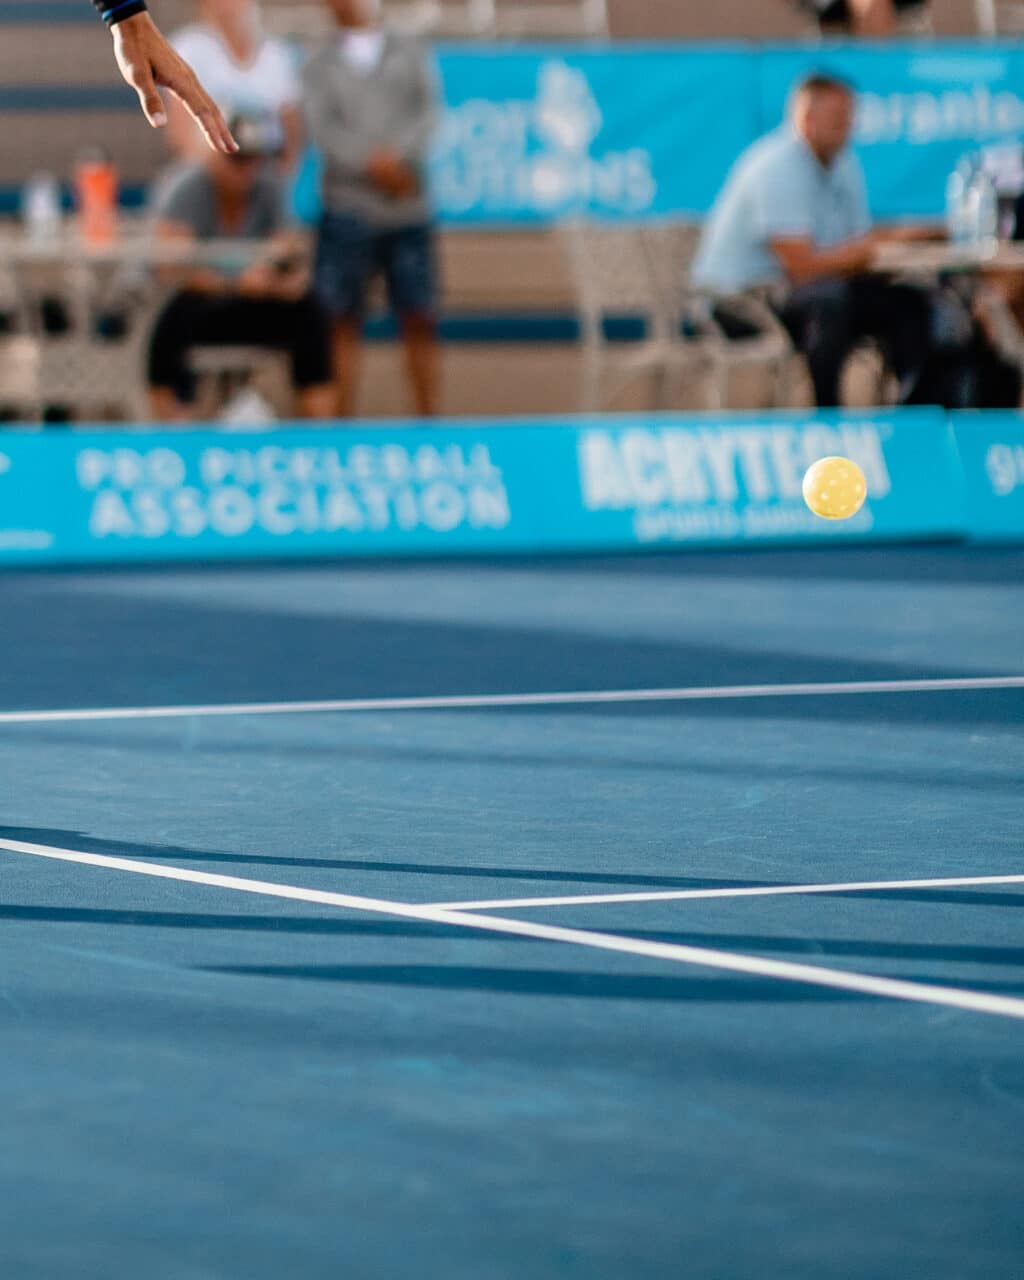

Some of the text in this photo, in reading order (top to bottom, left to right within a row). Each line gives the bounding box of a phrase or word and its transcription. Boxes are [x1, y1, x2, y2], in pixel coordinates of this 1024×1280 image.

[77, 442, 503, 489] PRO PICKLEBALL
[88, 478, 513, 538] ASSOCIATION
